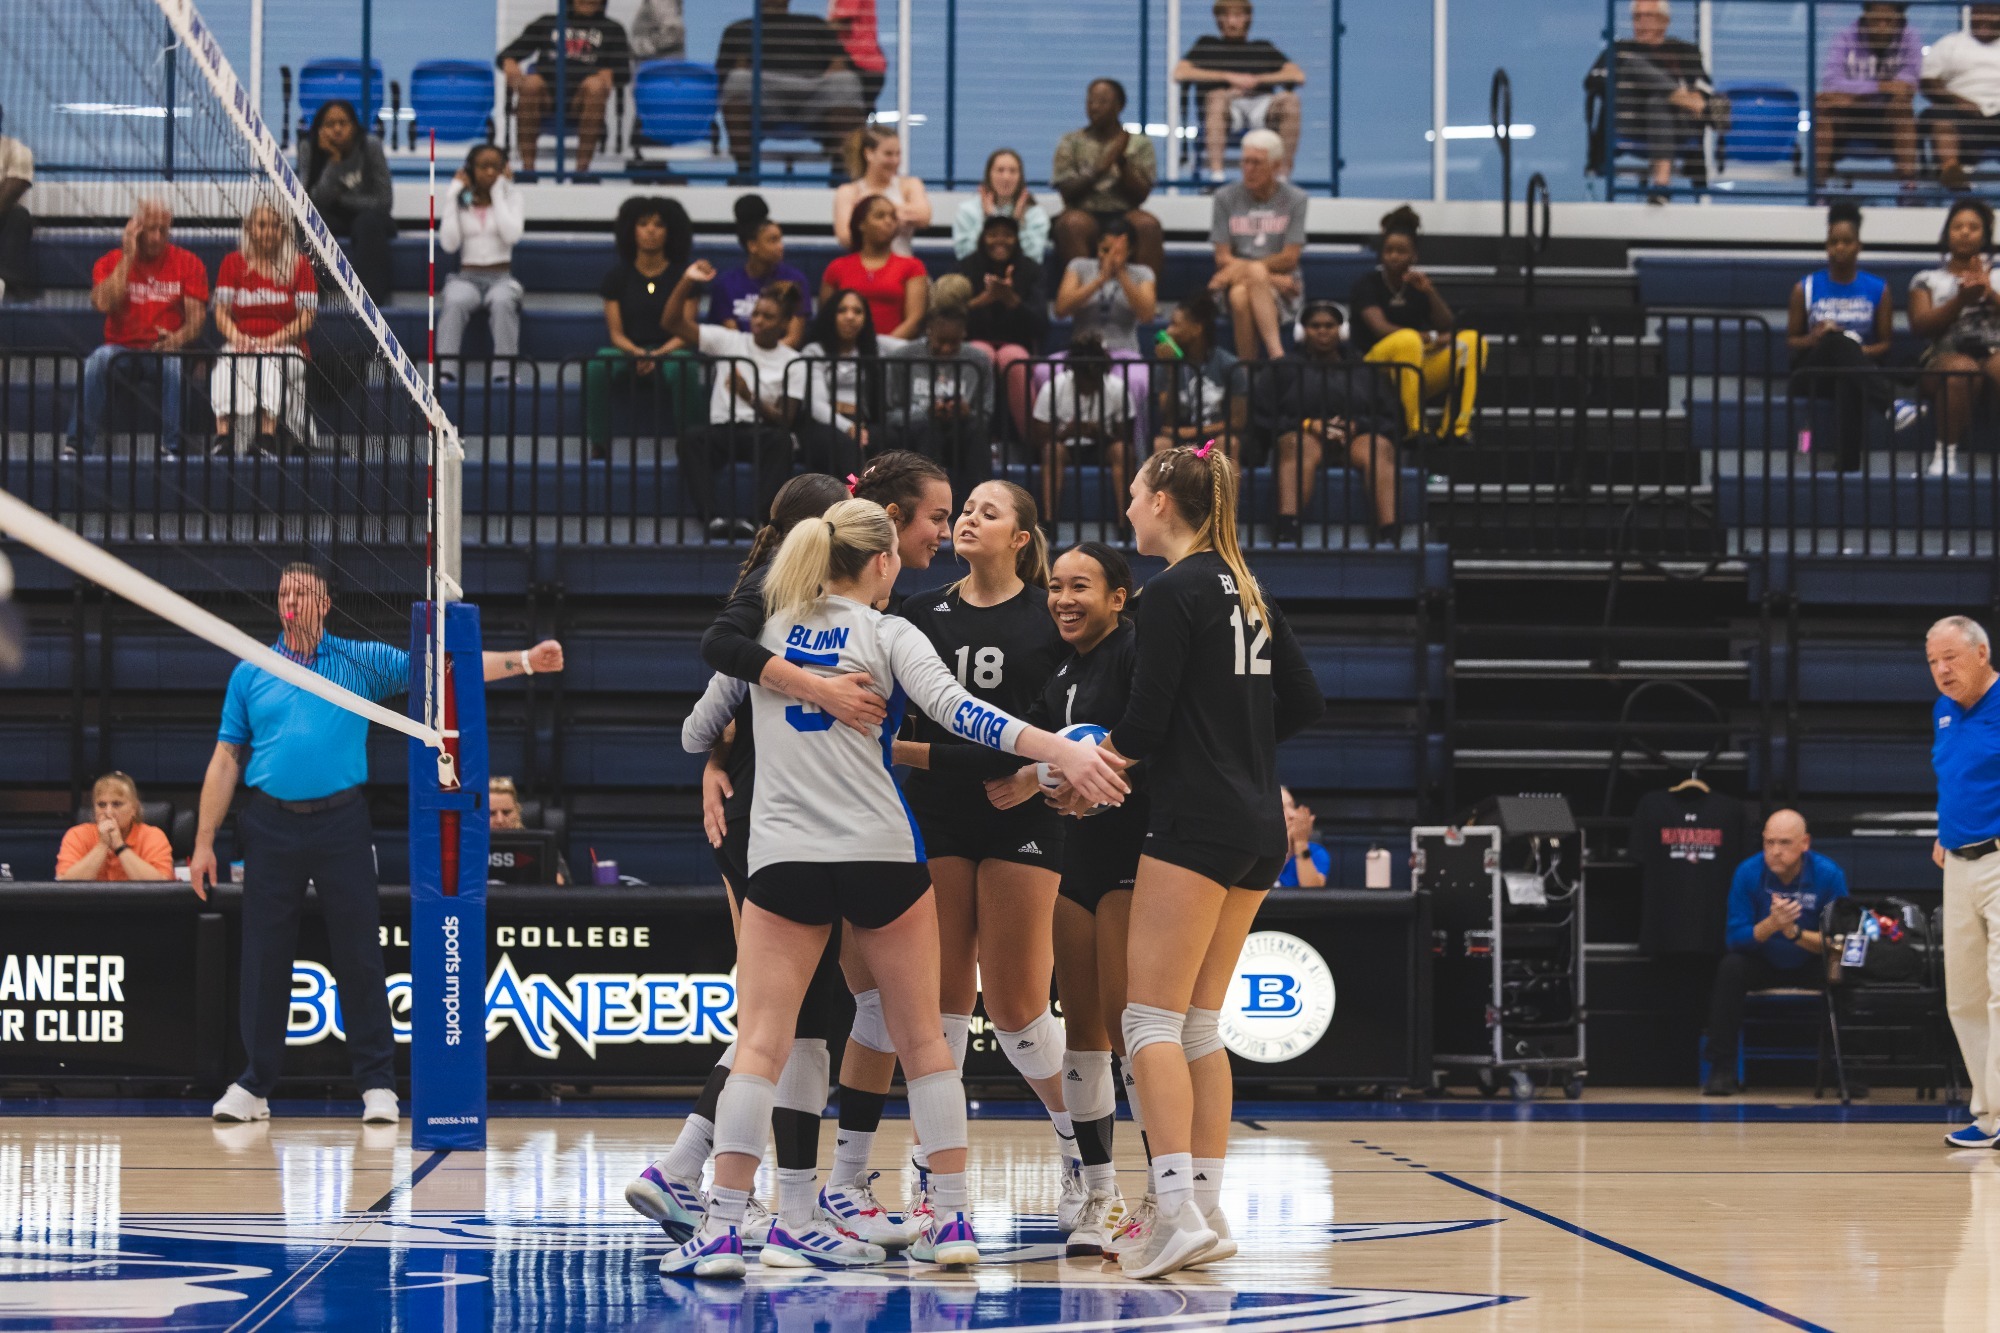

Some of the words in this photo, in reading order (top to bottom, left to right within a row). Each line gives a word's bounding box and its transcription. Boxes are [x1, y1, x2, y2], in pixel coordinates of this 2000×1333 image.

[786, 624, 849, 650] BLINN
[1230, 604, 1271, 675] 12
[955, 645, 1005, 689] 18
[952, 700, 1009, 750] BUCS
[1065, 683, 1077, 726] 1
[442, 915, 459, 973] sports
[496, 926, 650, 948] COLLEGE
[442, 975, 461, 1046] imports
[1241, 974, 1303, 1018] B
[36, 1009, 124, 1042] CLUB
